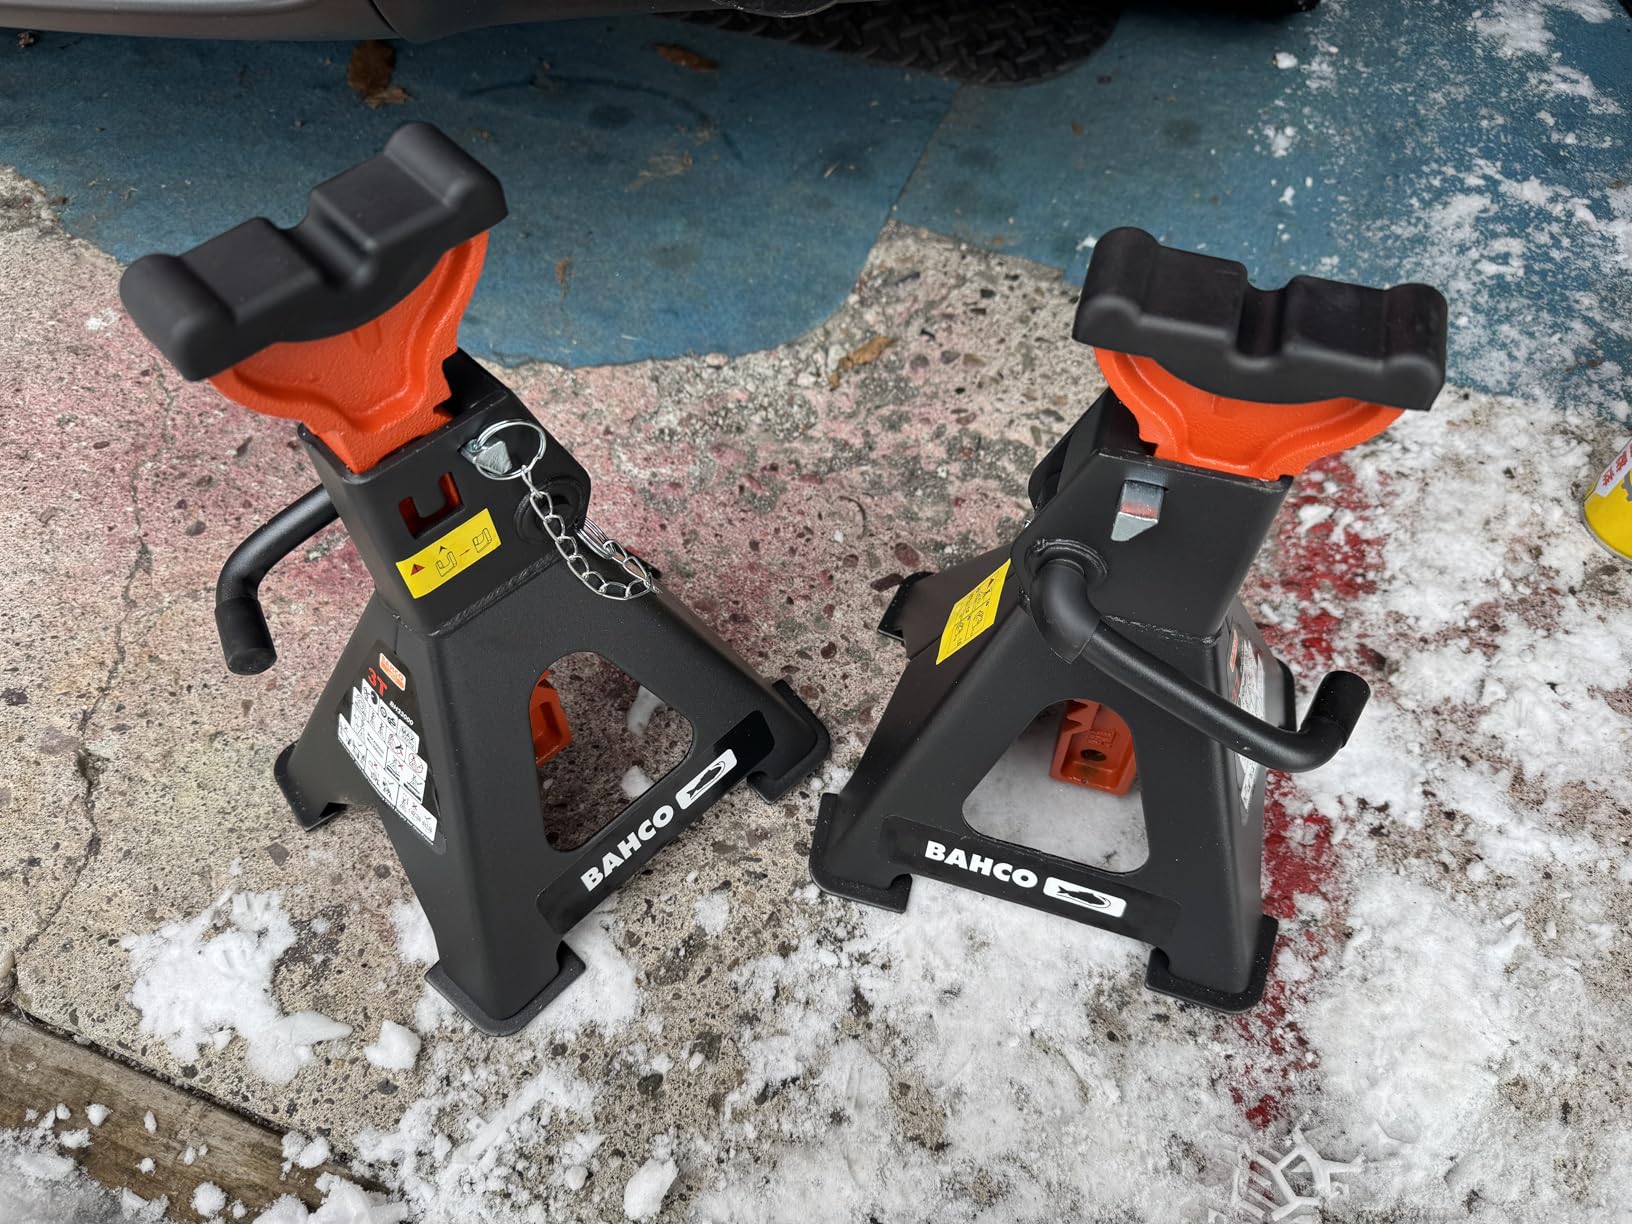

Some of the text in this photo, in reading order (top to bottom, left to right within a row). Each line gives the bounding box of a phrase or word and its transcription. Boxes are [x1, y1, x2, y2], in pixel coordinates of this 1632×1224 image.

[368, 666, 388, 697] 3T
[580, 805, 674, 892] BAHCO
[924, 840, 1038, 889] BAHCO
